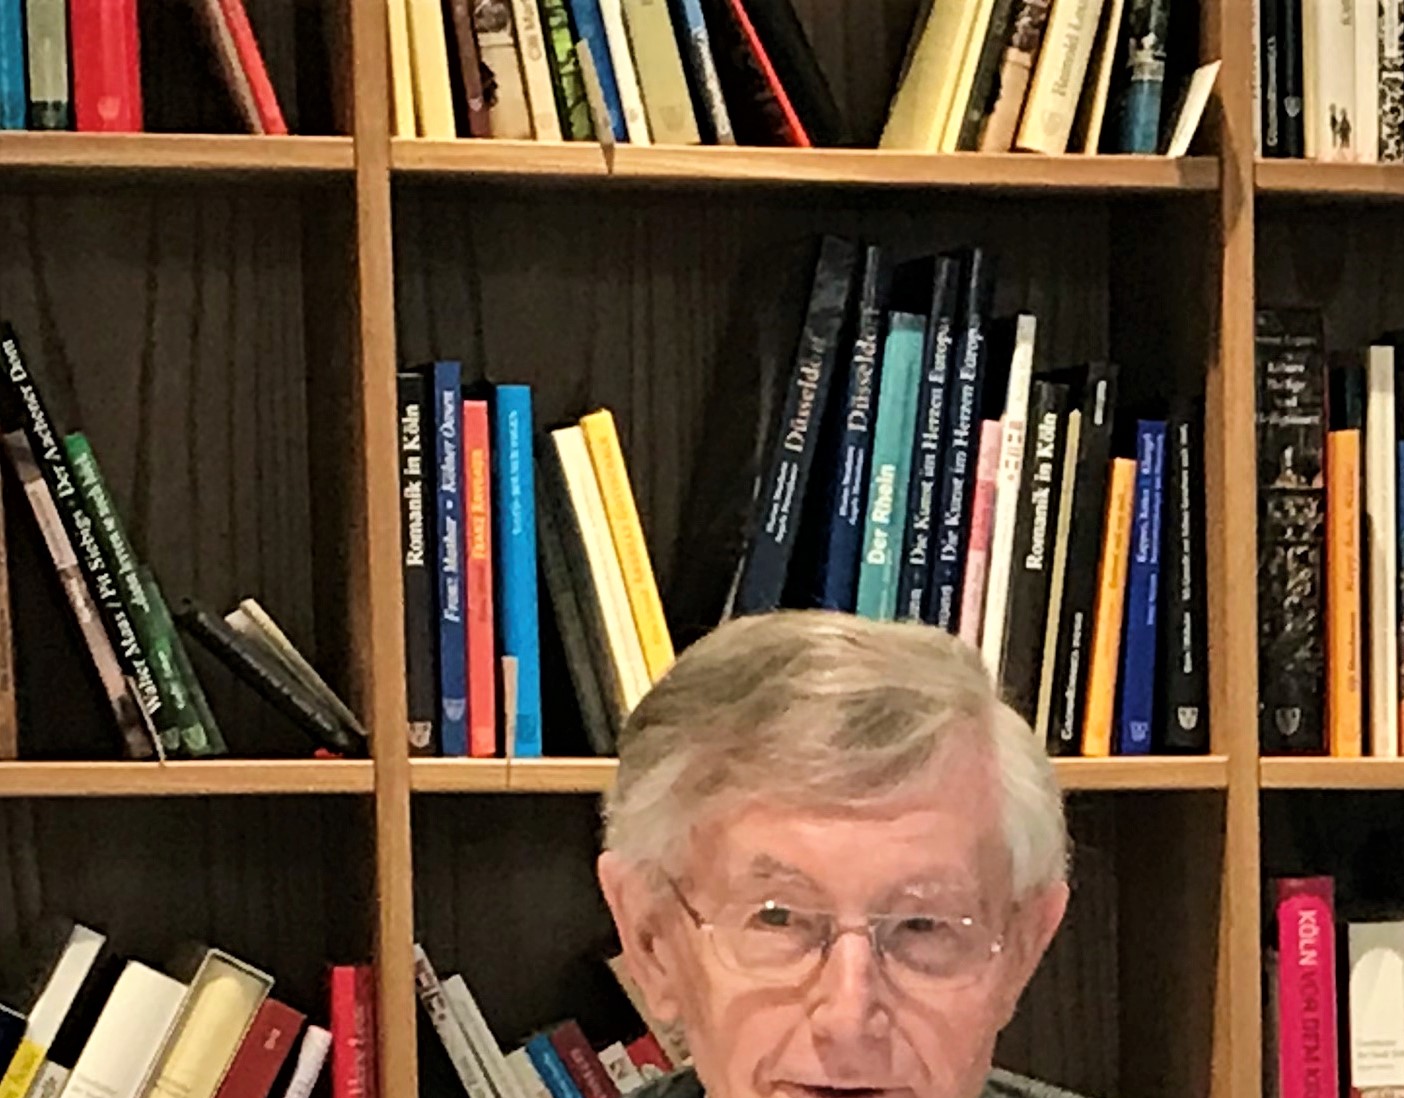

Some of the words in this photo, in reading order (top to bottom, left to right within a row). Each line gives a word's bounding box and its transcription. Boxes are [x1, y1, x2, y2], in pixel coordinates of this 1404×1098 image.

[0, 338, 28, 384] Dom
[13, 382, 62, 465] Aachener
[398, 404, 421, 451] Köln
[920, 387, 943, 450] Herzen
[952, 383, 974, 448] Herzen
[1033, 410, 1058, 459] Köln
[47, 461, 75, 499] Der
[401, 456, 421, 475] in
[918, 452, 936, 476] im
[949, 451, 967, 473] im
[1032, 461, 1053, 482] in
[870, 462, 895, 524] Rhein
[913, 480, 933, 529] Kunst
[944, 477, 965, 526] Kunst
[402, 480, 424, 565] Romanik
[940, 530, 959, 561] Die
[1022, 486, 1052, 570] Romanik
[865, 527, 888, 565] Der
[909, 532, 928, 565] Die
[92, 571, 117, 600] Pit
[127, 657, 163, 713] Walter
[1297, 910, 1320, 965] KÖLN
[1301, 971, 1318, 1011] VOR
[1301, 1017, 1320, 1062] DEM
